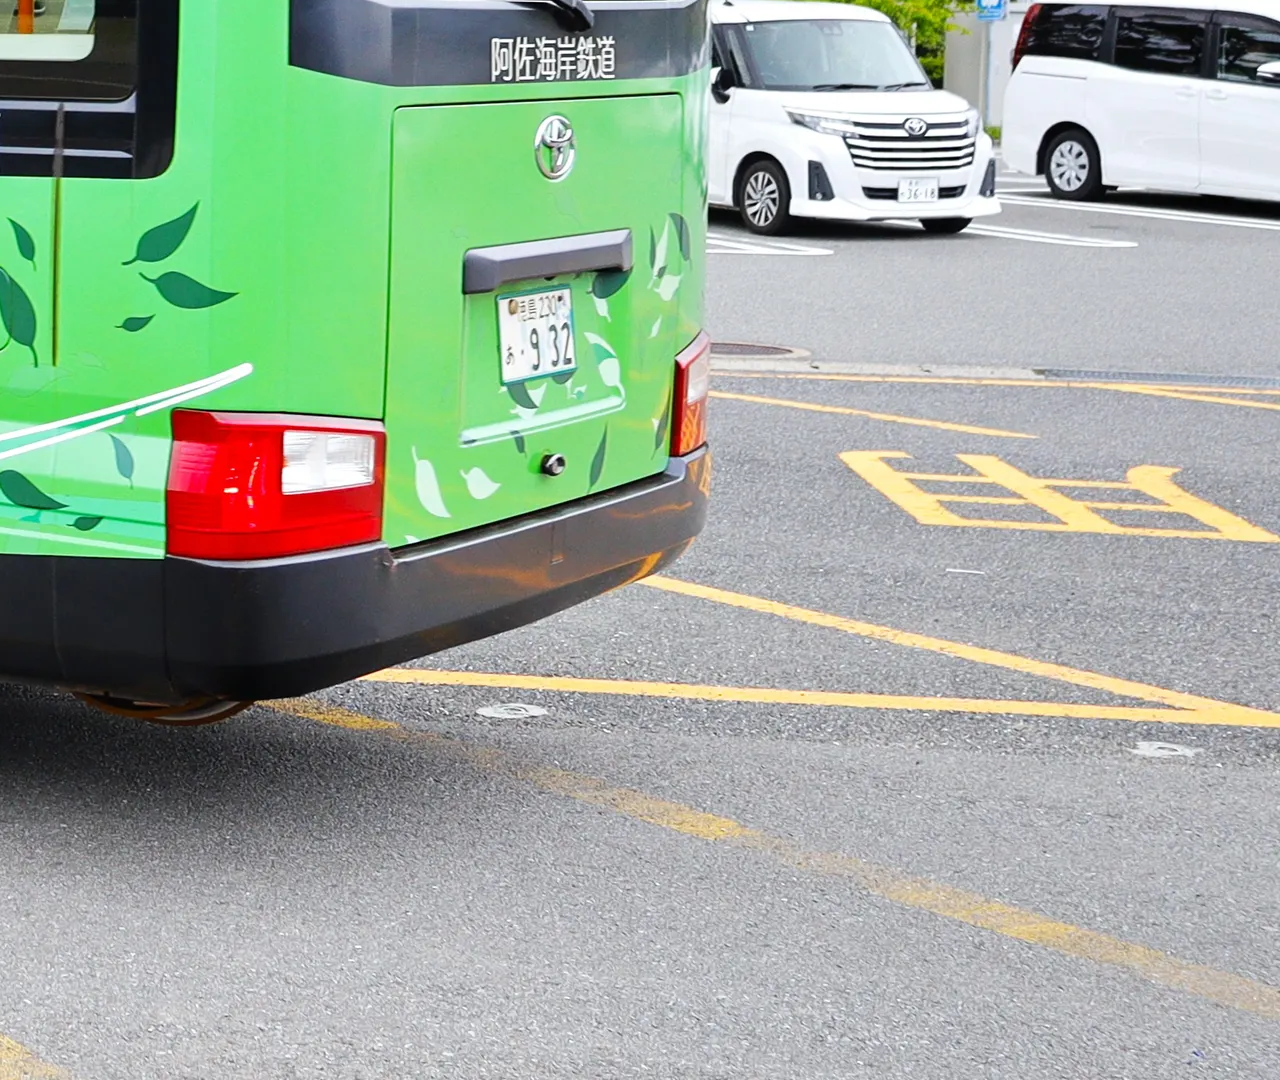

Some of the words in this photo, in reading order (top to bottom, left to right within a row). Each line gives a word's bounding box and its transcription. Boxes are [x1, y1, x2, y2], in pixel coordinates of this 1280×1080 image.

[490, 35, 616, 82] 阿佐海岸鉄道
